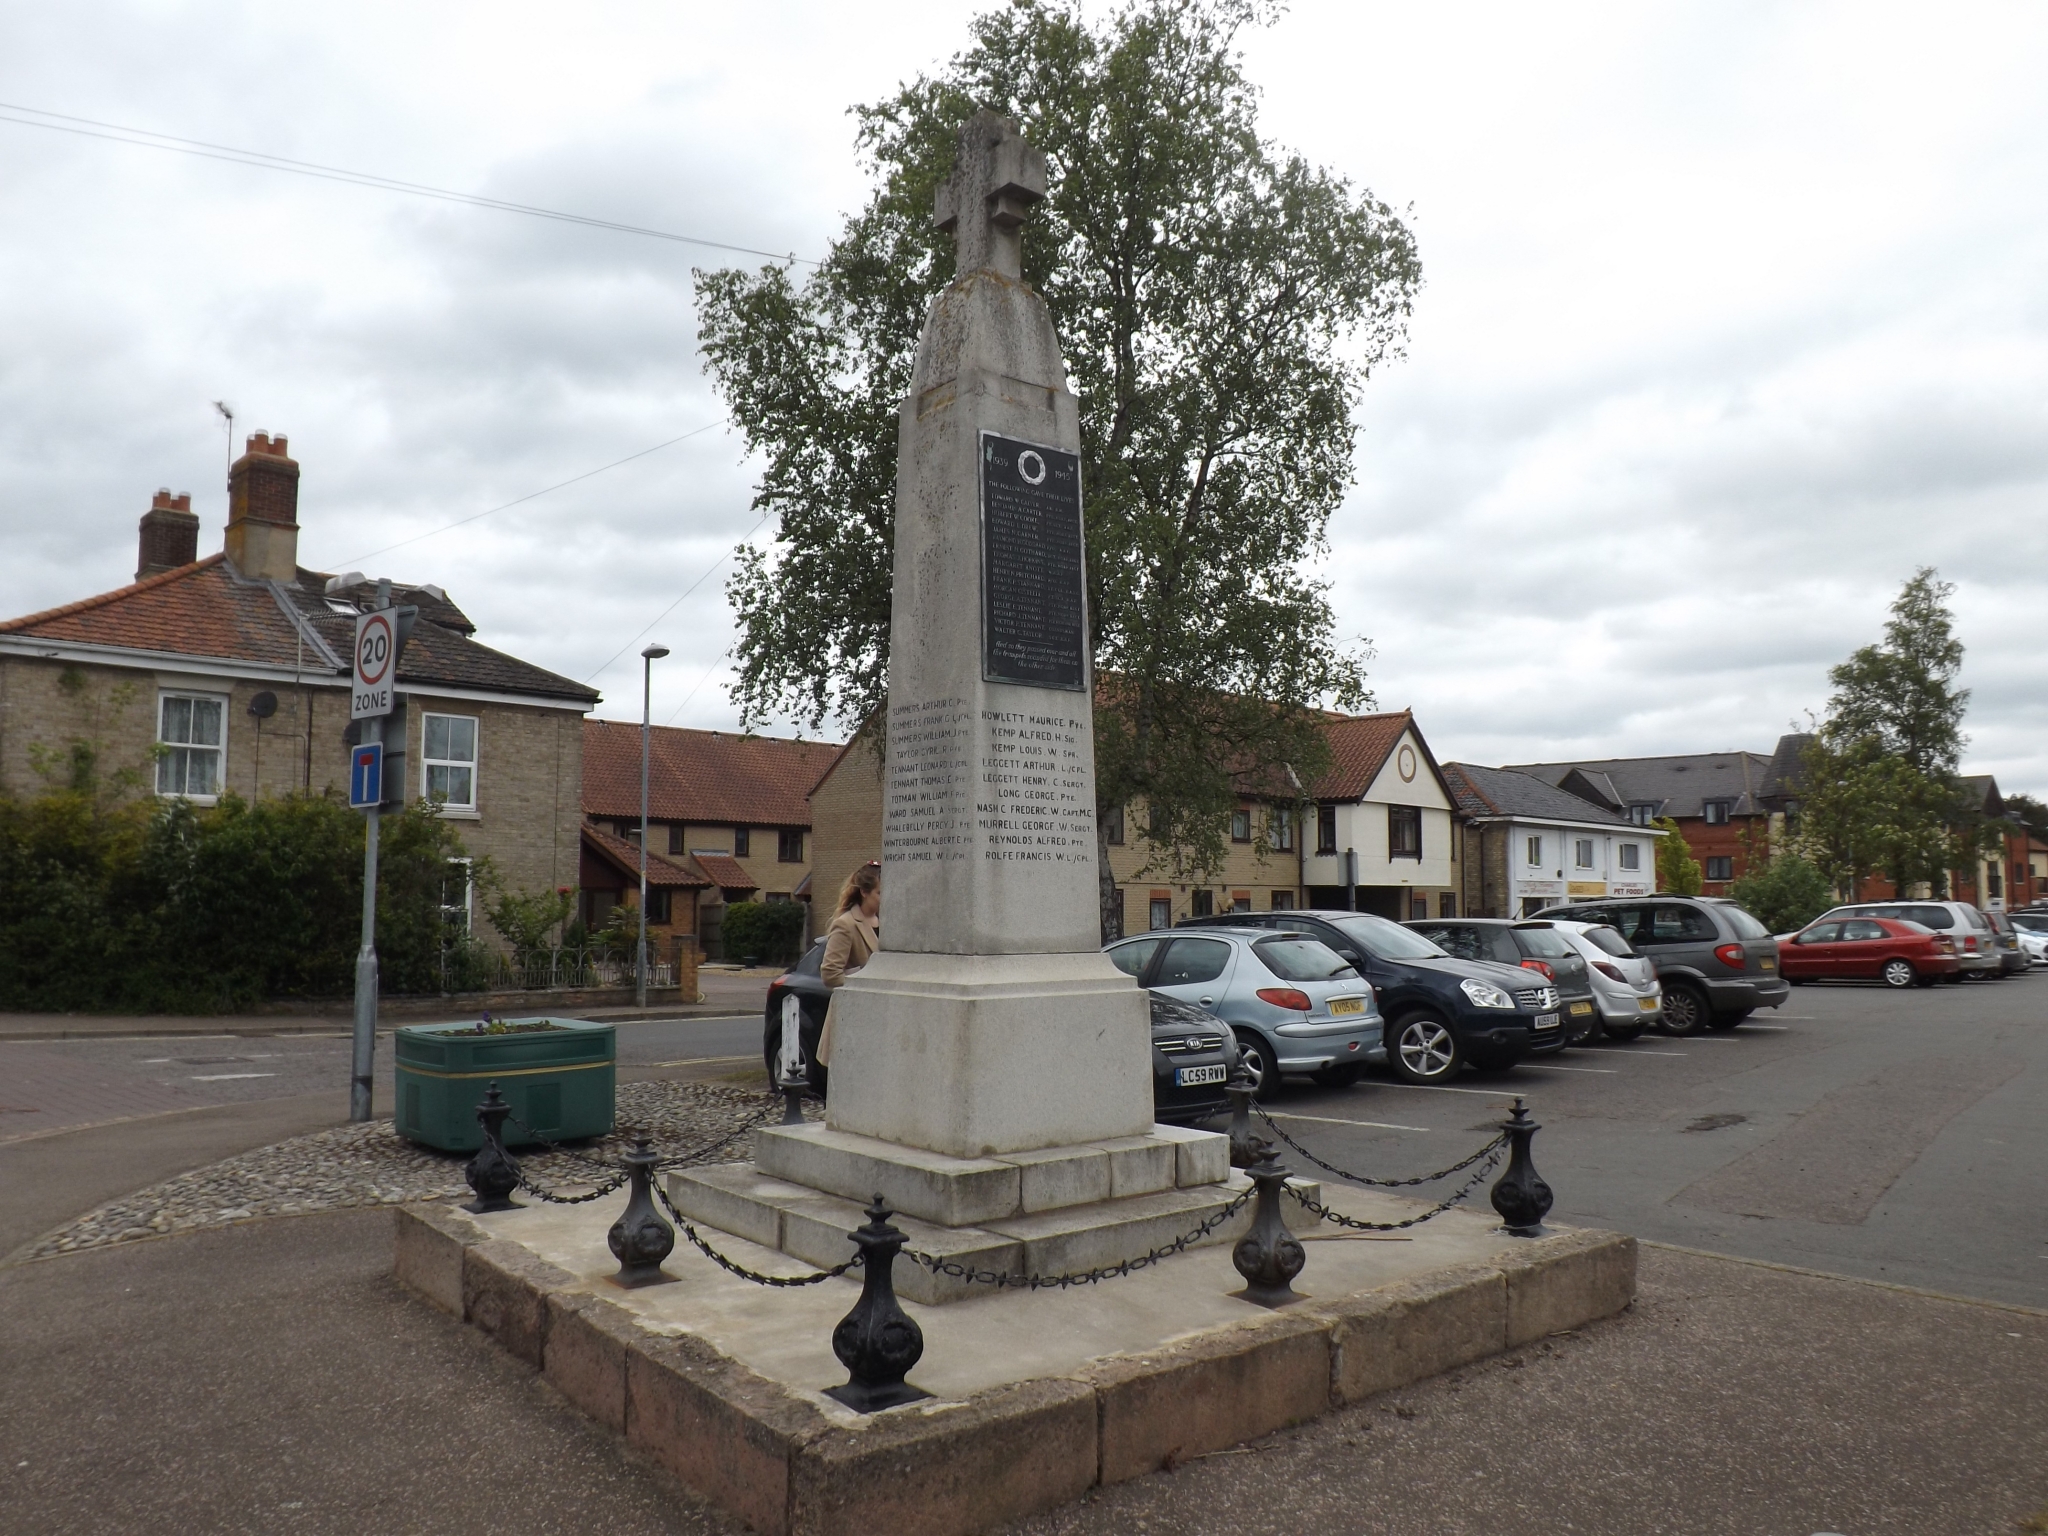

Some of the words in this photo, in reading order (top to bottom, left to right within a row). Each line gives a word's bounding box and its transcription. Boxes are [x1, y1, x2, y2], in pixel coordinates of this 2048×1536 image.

[362, 634, 387, 665] 20
[355, 691, 387, 712] ZONE
[892, 704, 920, 716] SUMMERS
[921, 700, 947, 711] ARTHUR
[981, 711, 1025, 723] HOWLETT
[892, 718, 921, 731] SUMMERS
[923, 715, 944, 726] FRANK
[992, 728, 1016, 739] KEMP
[992, 744, 1016, 753] KEMP
[896, 749, 919, 760] TAYLOR
[982, 757, 1021, 769] LEGGETT
[891, 763, 919, 775] TENNANT
[983, 773, 1019, 784] LEGGETT
[891, 794, 917, 804] TOTMAN
[920, 791, 948, 801] WILLIAM
[998, 788, 1020, 799] LONG
[889, 809, 907, 819] WARD
[910, 806, 936, 817] SAMUEL
[977, 803, 998, 814] NASH
[885, 822, 925, 832] WHALEBELLY
[927, 820, 949, 830] PERCY
[979, 819, 1020, 830] MURRELL
[883, 837, 929, 847] WINTERBOURNE
[989, 835, 1033, 846] REYNOLDS
[883, 853, 906, 862] WRIGHT
[907, 852, 932, 862] SAMUEL
[985, 851, 1013, 861] ROLFE
[1016, 852, 1051, 861] FRANCIS
[1181, 1069, 1206, 1083] LC59
